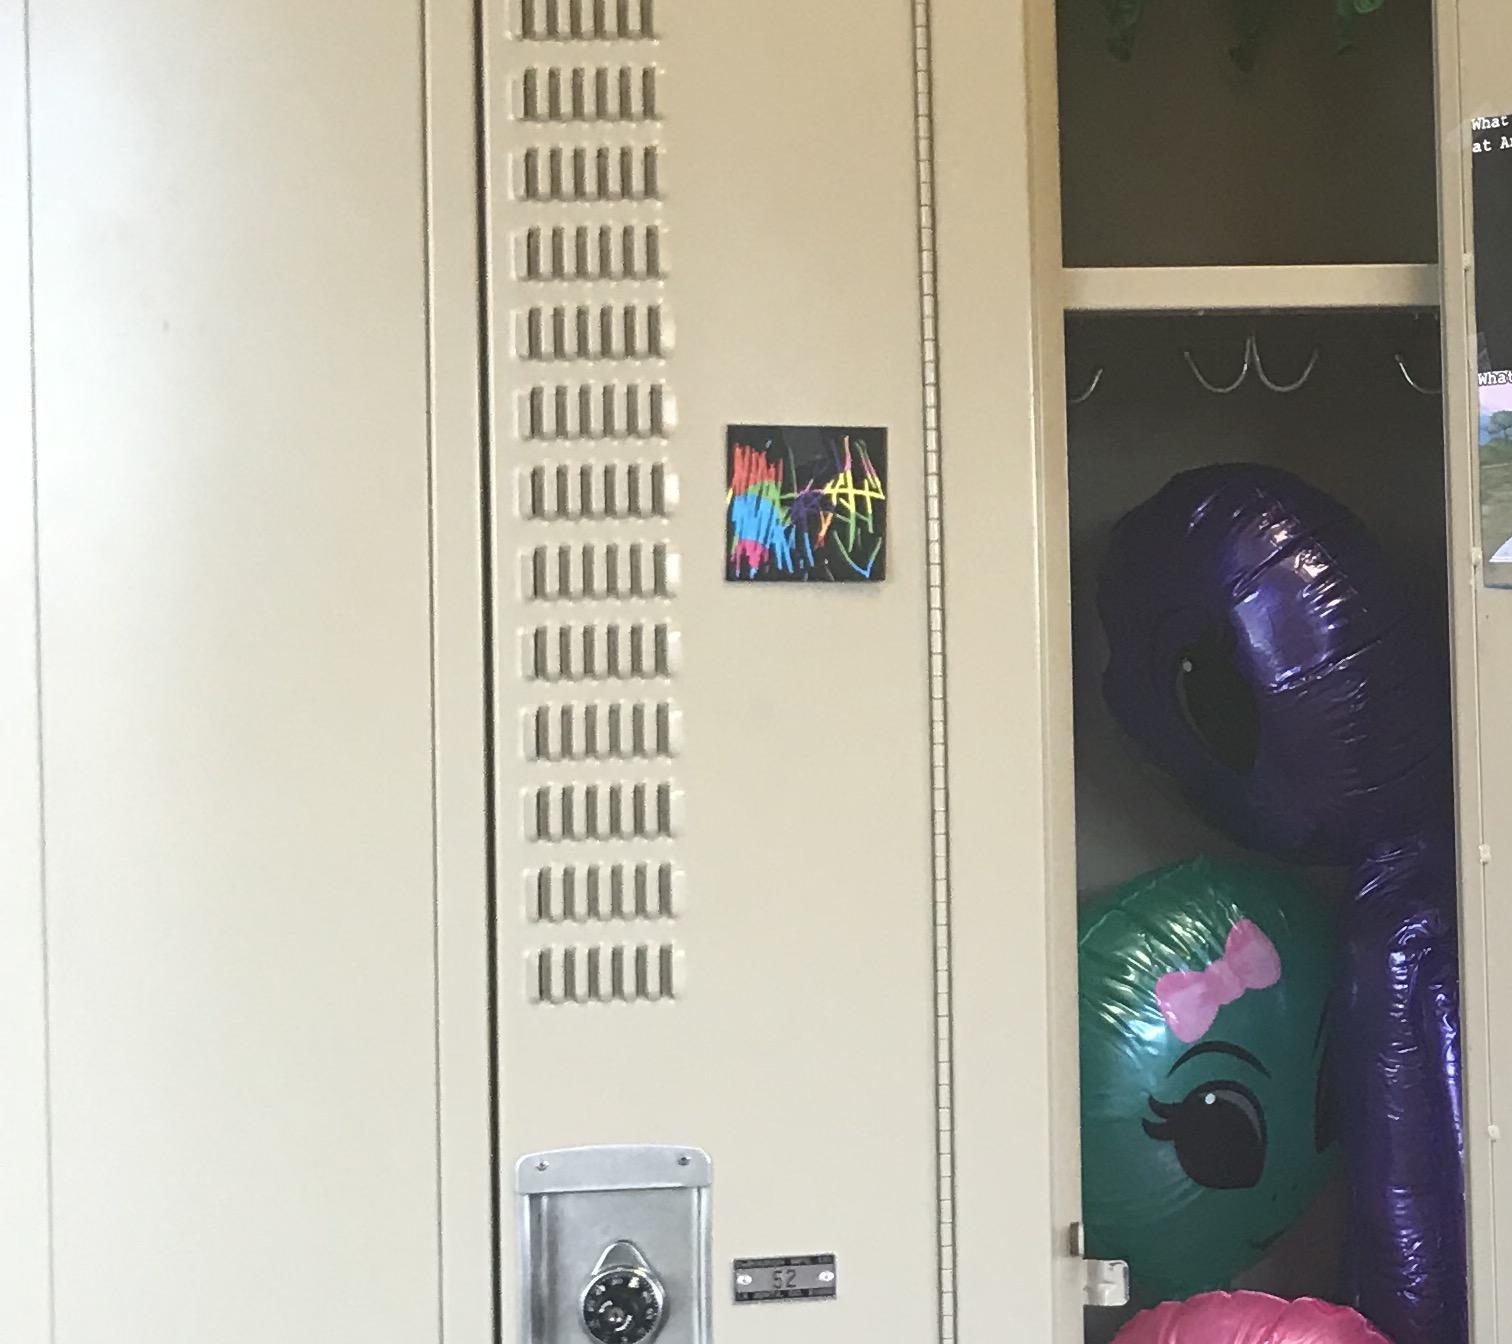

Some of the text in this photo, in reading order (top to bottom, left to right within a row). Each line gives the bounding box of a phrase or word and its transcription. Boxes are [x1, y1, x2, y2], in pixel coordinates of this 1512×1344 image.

[1472, 115, 1508, 131] What
[1472, 139, 1492, 153] at
[773, 1268, 797, 1289] 52
